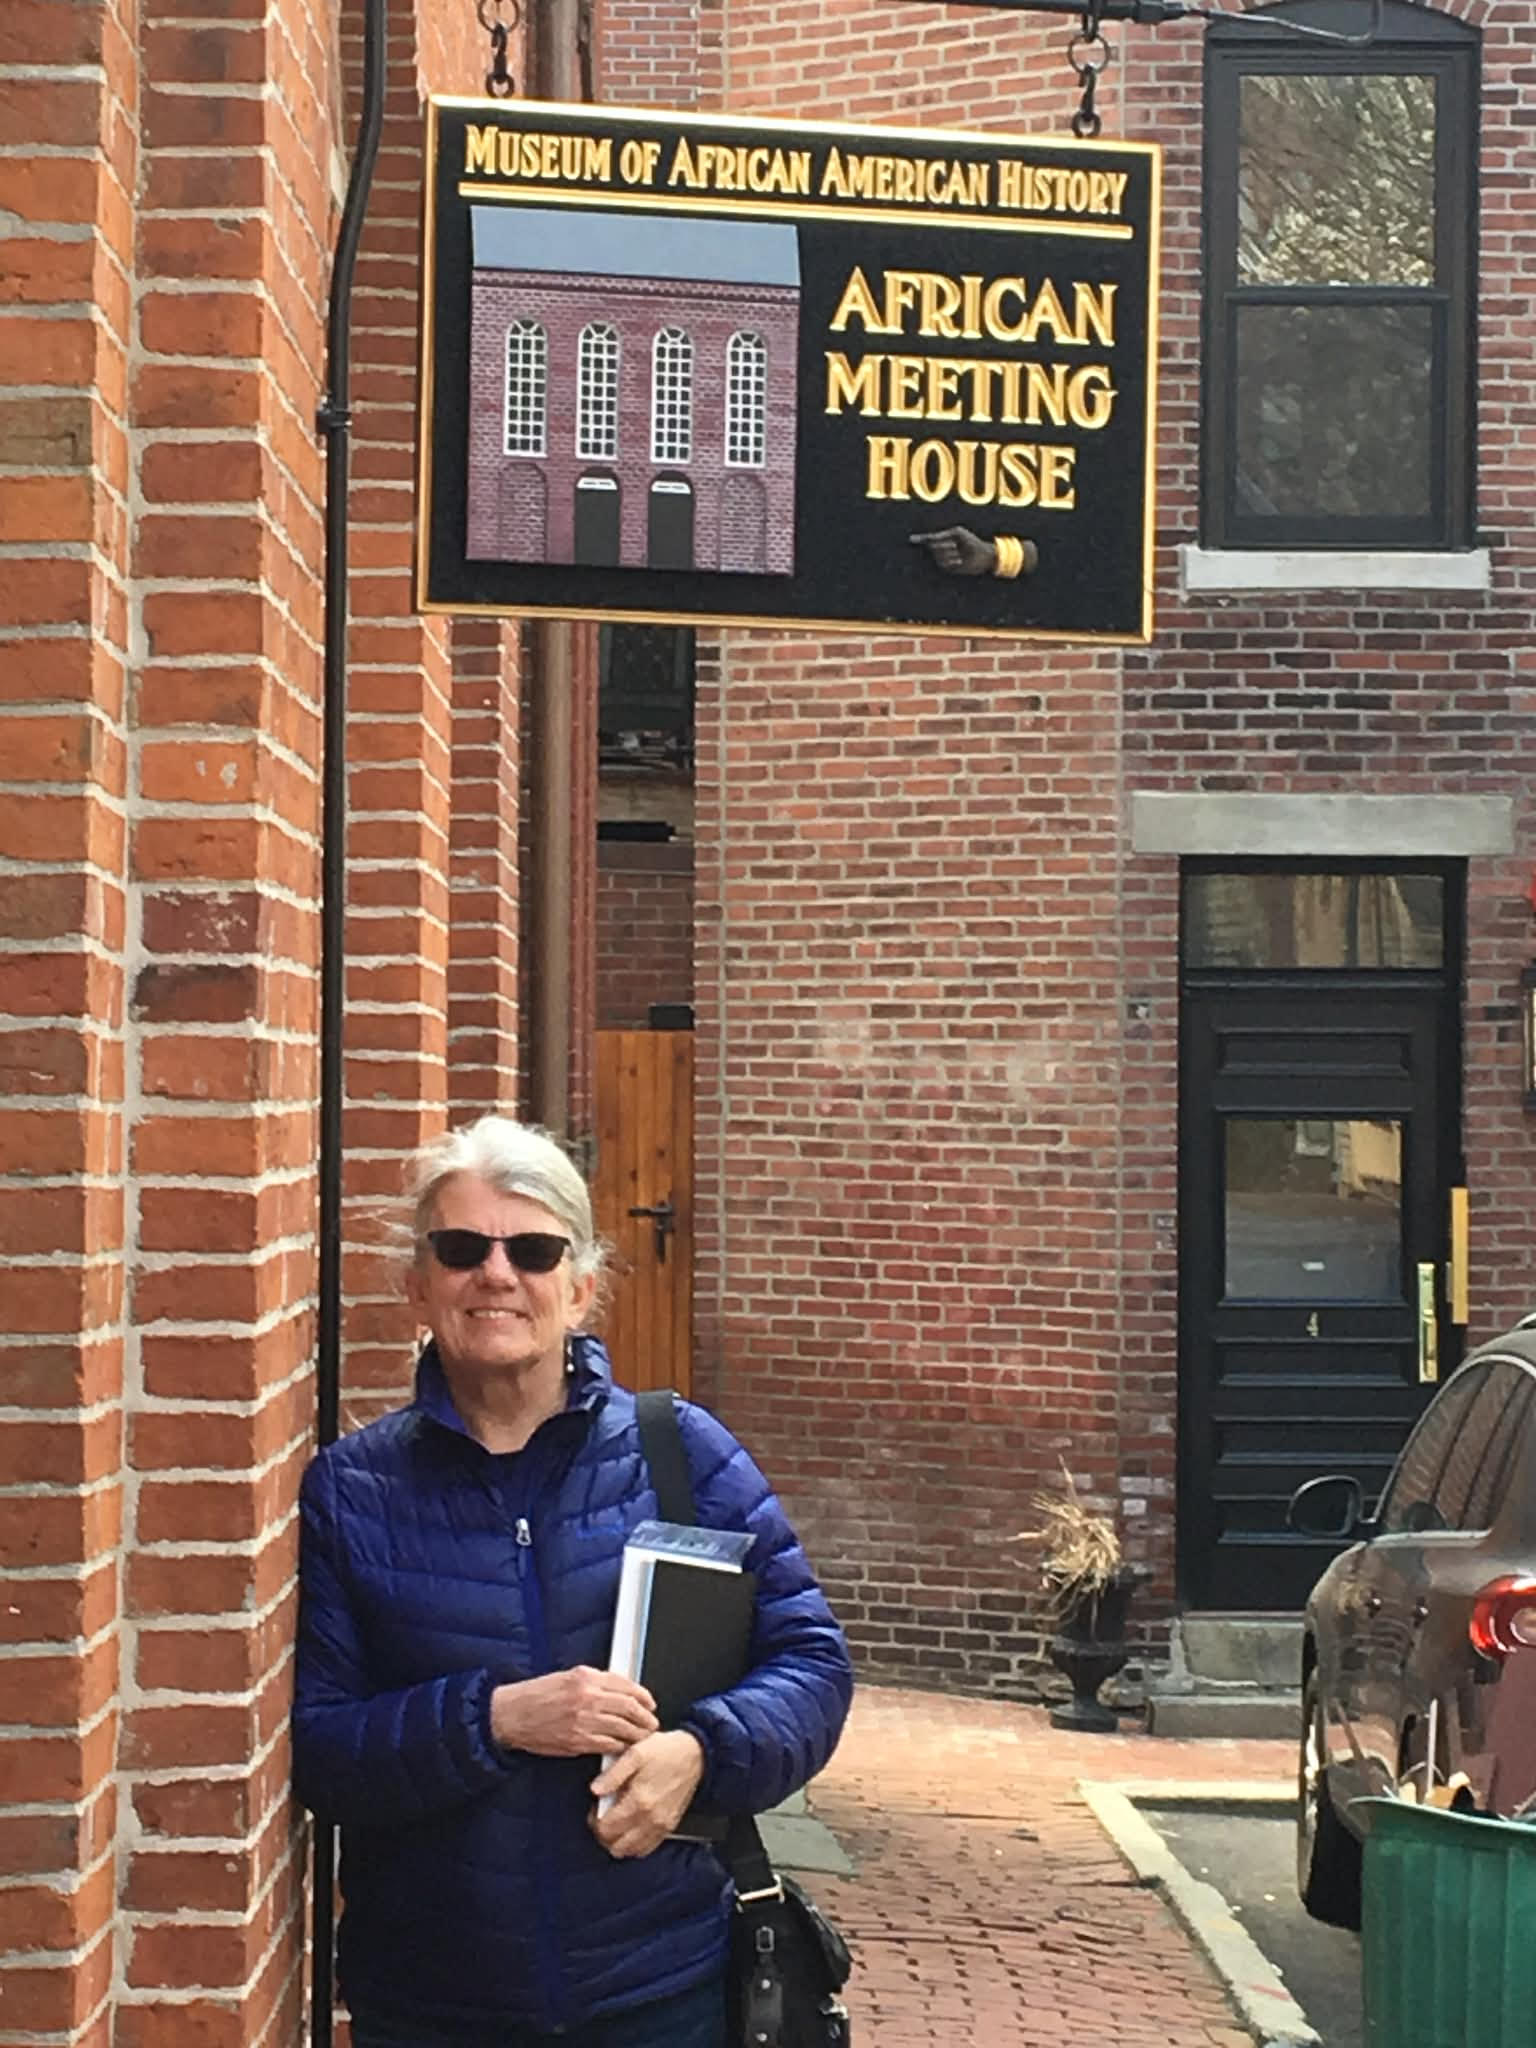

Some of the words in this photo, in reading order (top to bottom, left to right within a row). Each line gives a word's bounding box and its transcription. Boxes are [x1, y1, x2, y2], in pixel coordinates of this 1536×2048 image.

[464, 123, 613, 182] MUSEUM
[619, 139, 661, 186] OF
[667, 136, 811, 196] AFRICAN
[819, 146, 990, 207] AMERICAN
[997, 160, 1129, 216] HISTORY
[828, 265, 1119, 348] AFRICAN
[823, 351, 1119, 430] MEETING
[865, 435, 1076, 510] HOUSE
